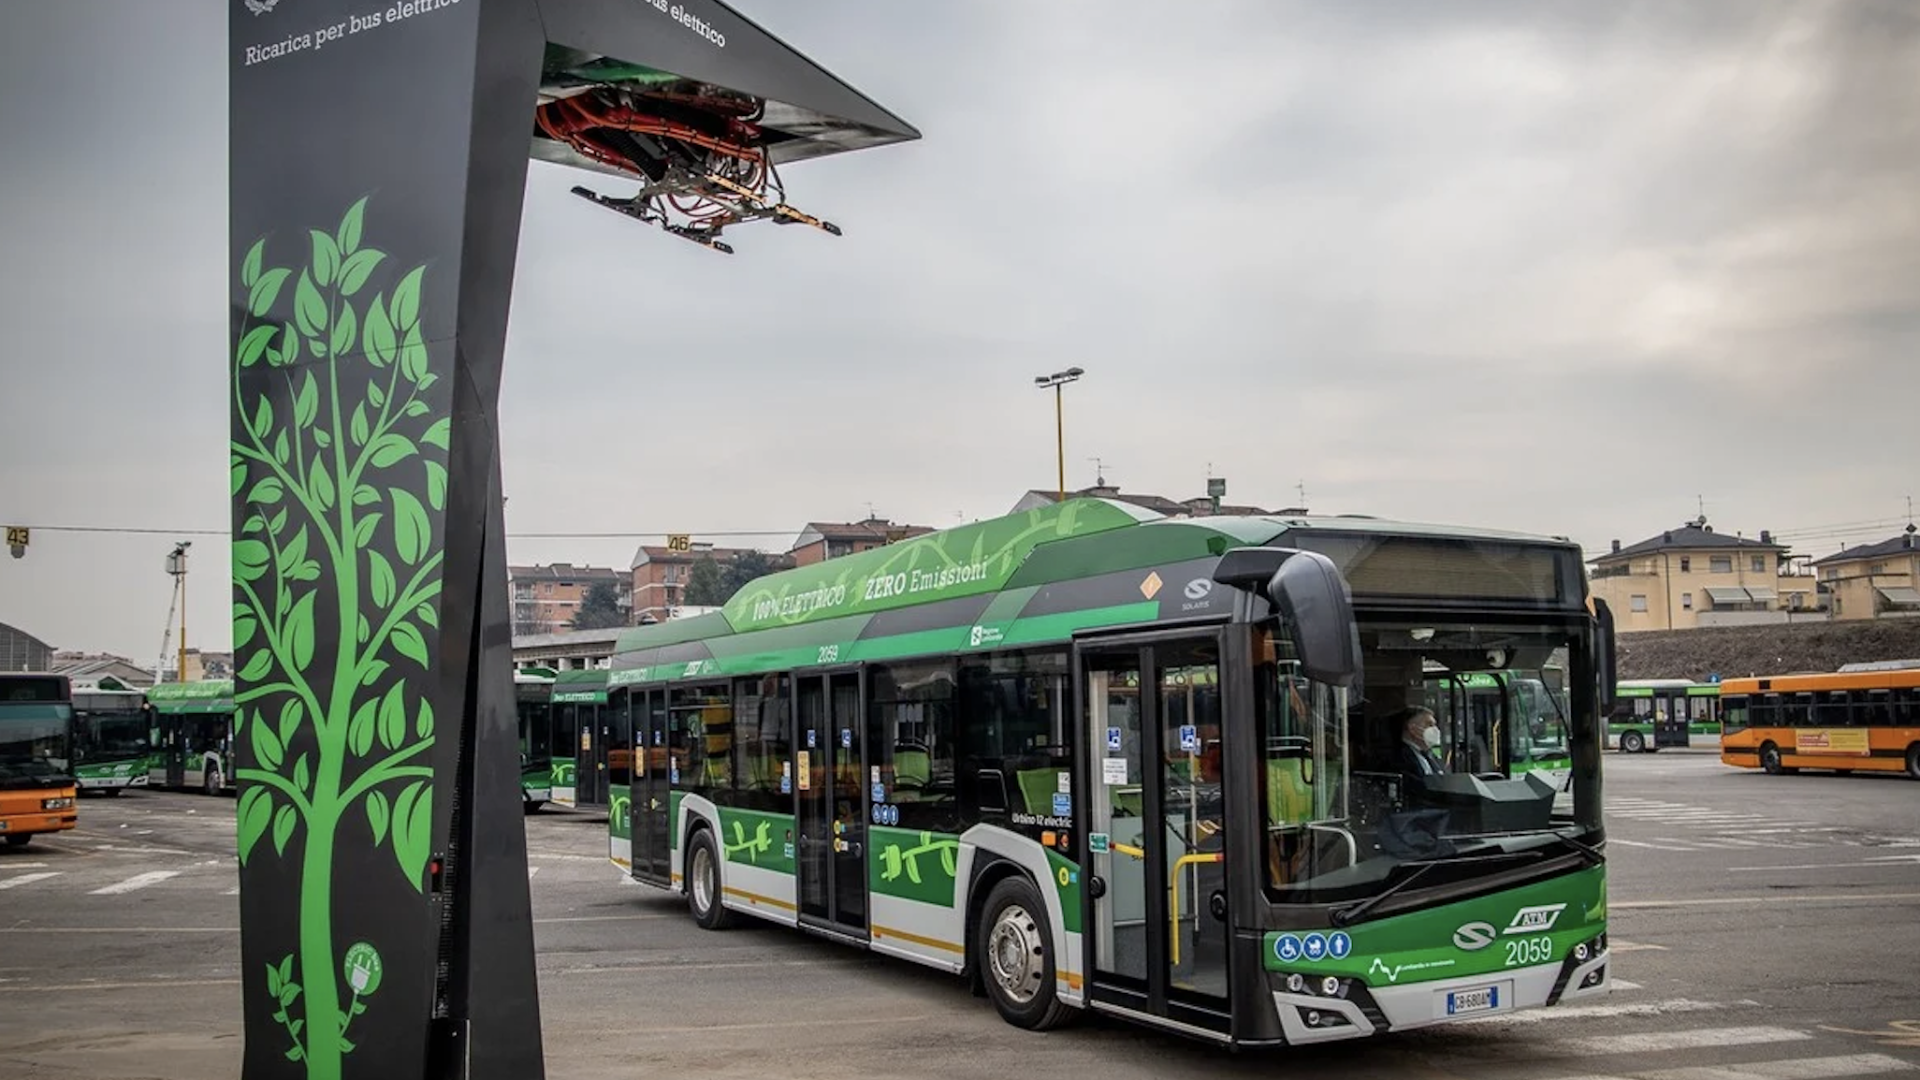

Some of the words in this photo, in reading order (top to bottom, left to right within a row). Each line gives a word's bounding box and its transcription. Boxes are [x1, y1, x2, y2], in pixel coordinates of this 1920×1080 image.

[245, 32, 312, 66] Ricarica
[314, 22, 348, 50] per
[349, 12, 382, 35] bus
[385, 0, 460, 22] elettri
[646, 0, 668, 13] us
[669, 4, 726, 48] elettrico
[7, 528, 29, 545] 43
[668, 536, 688, 551] 46
[752, 599, 781, 621] 100%
[780, 584, 846, 616] ELETTRICO
[864, 572, 907, 601] ZERO
[908, 554, 989, 593] Emissioni
[1012, 812, 1036, 825] Urbino
[1036, 814, 1045, 827] 12
[1044, 815, 1073, 829] electric
[1505, 936, 1552, 966] 2059
